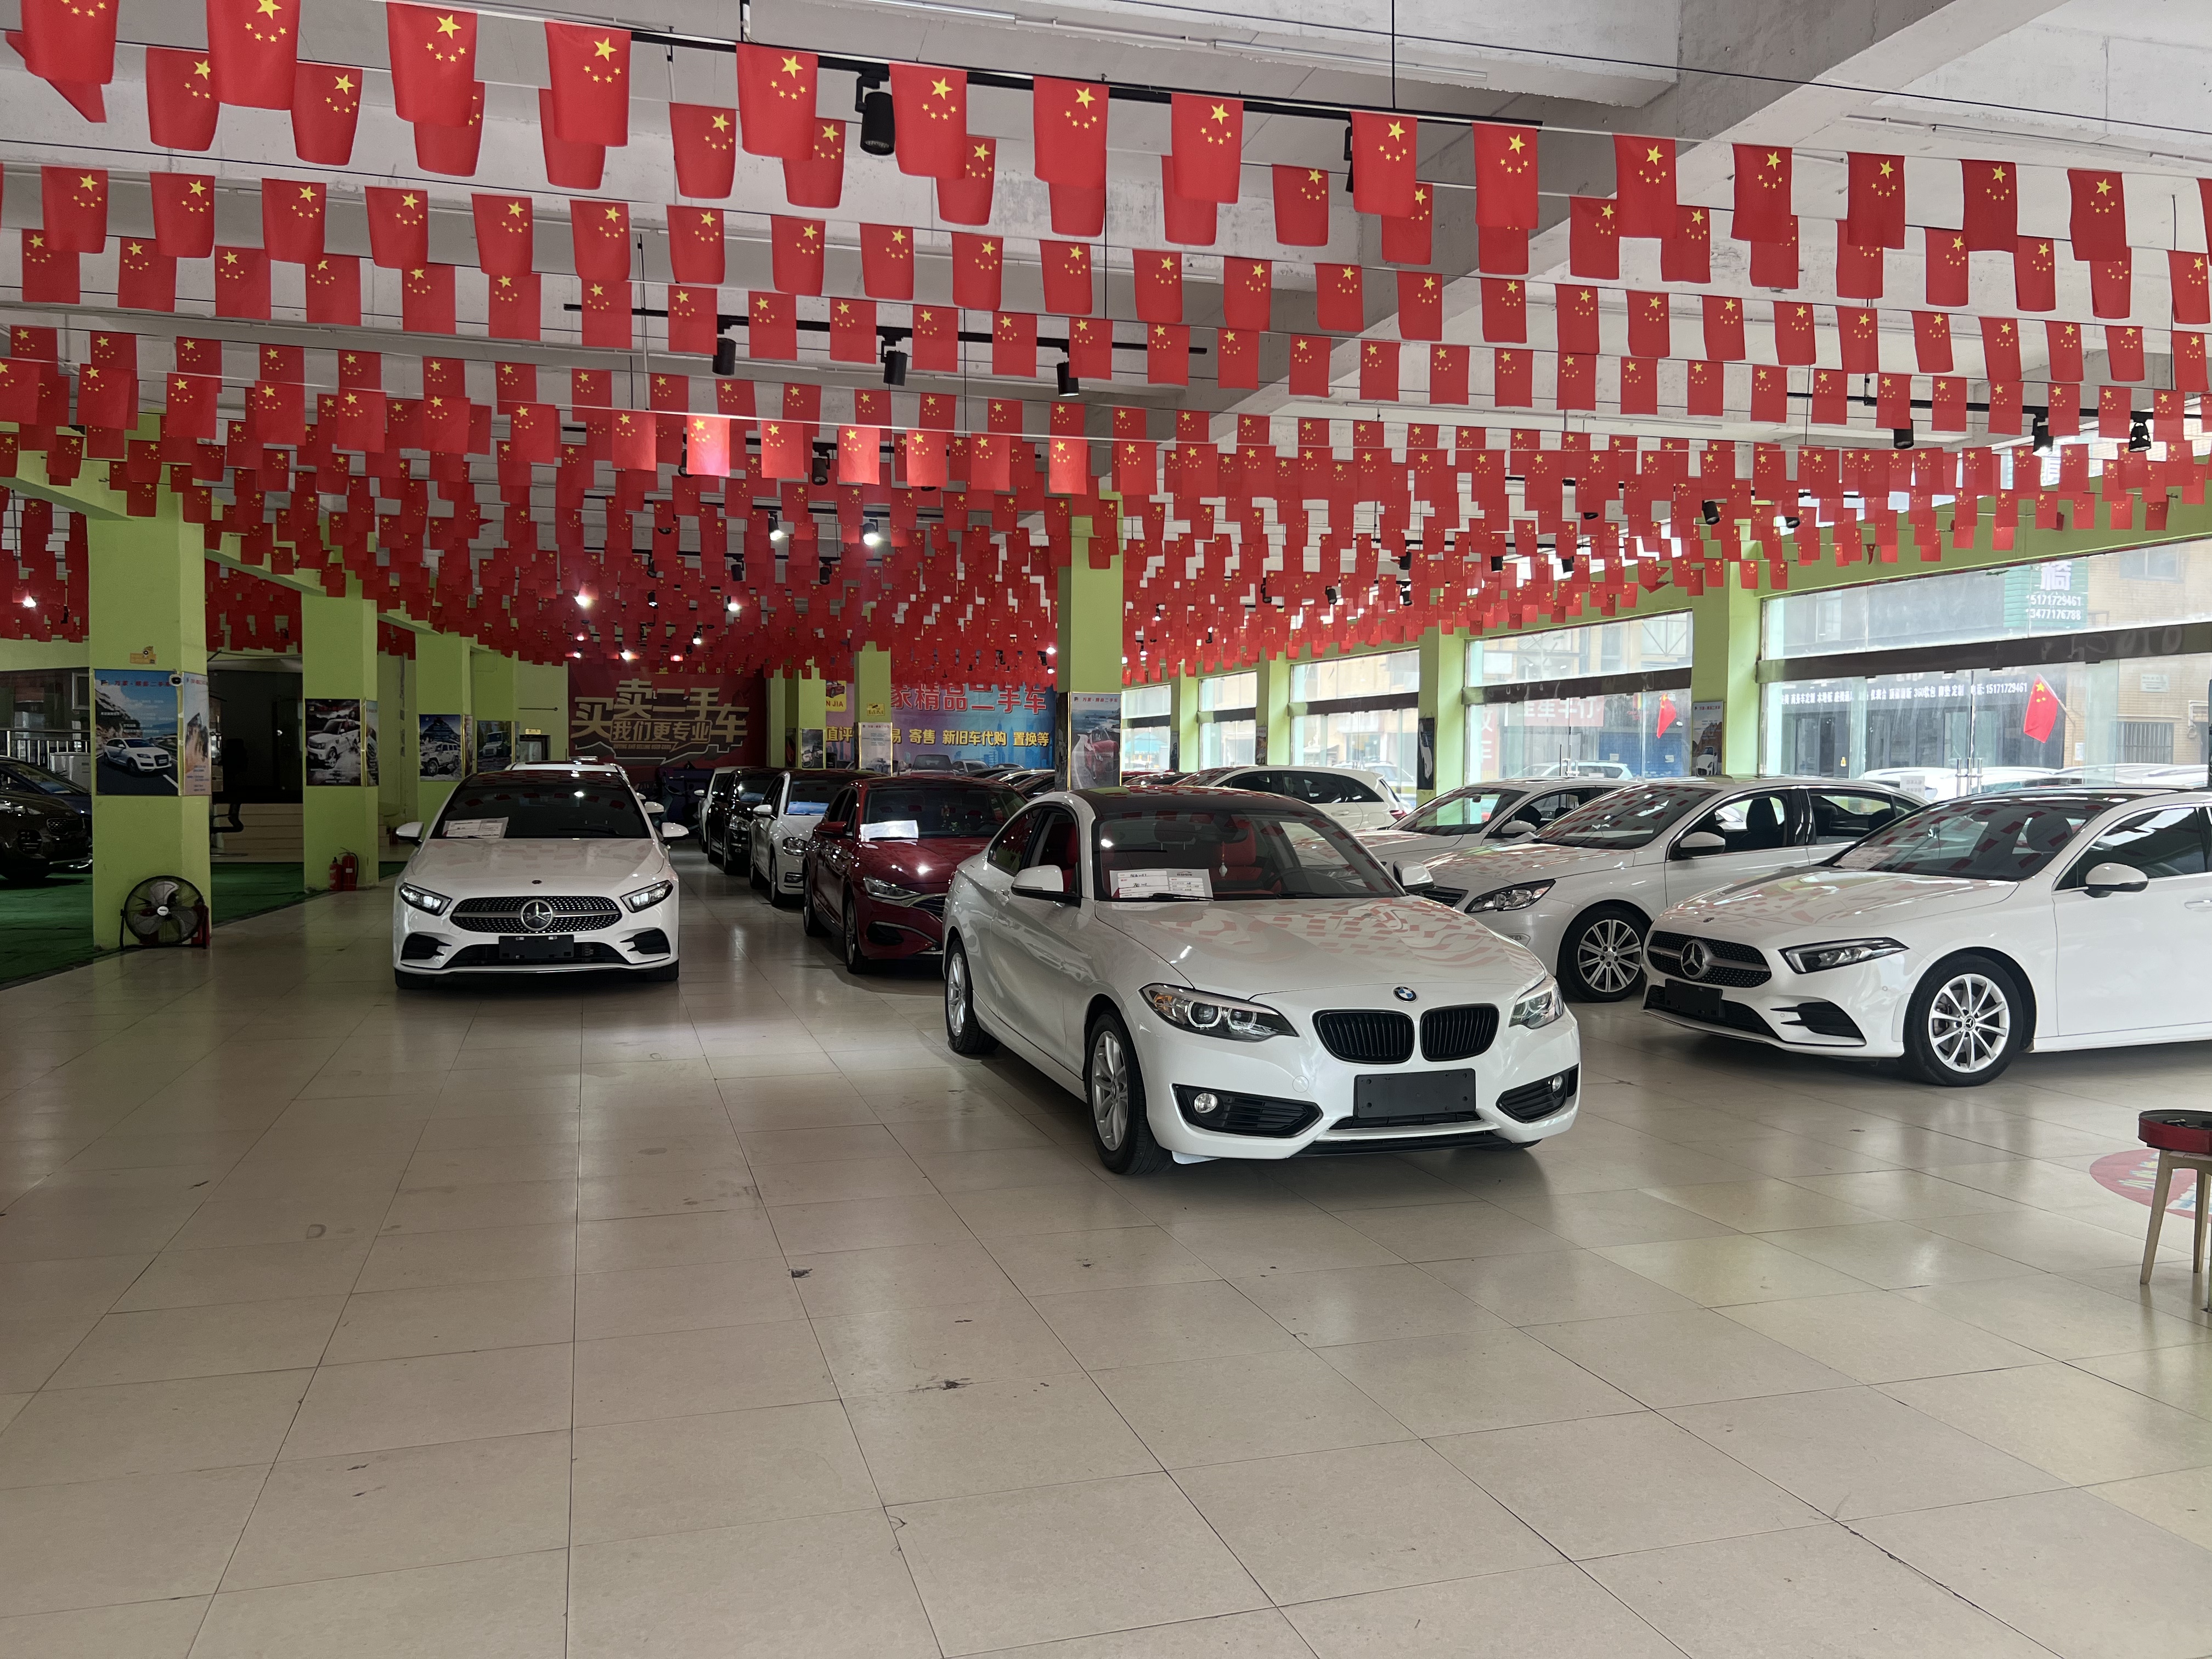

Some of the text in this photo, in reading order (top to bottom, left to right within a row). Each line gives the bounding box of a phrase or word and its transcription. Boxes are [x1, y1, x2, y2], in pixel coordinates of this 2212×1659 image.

[2040, 560, 2072, 591] 椅
[571, 678, 750, 743] 买卖二手车
[613, 721, 709, 742] 我们更专业
[909, 729, 935, 744] 寄售
[942, 729, 1006, 746] 新旧车代购
[1013, 732, 1049, 747] 置换等
